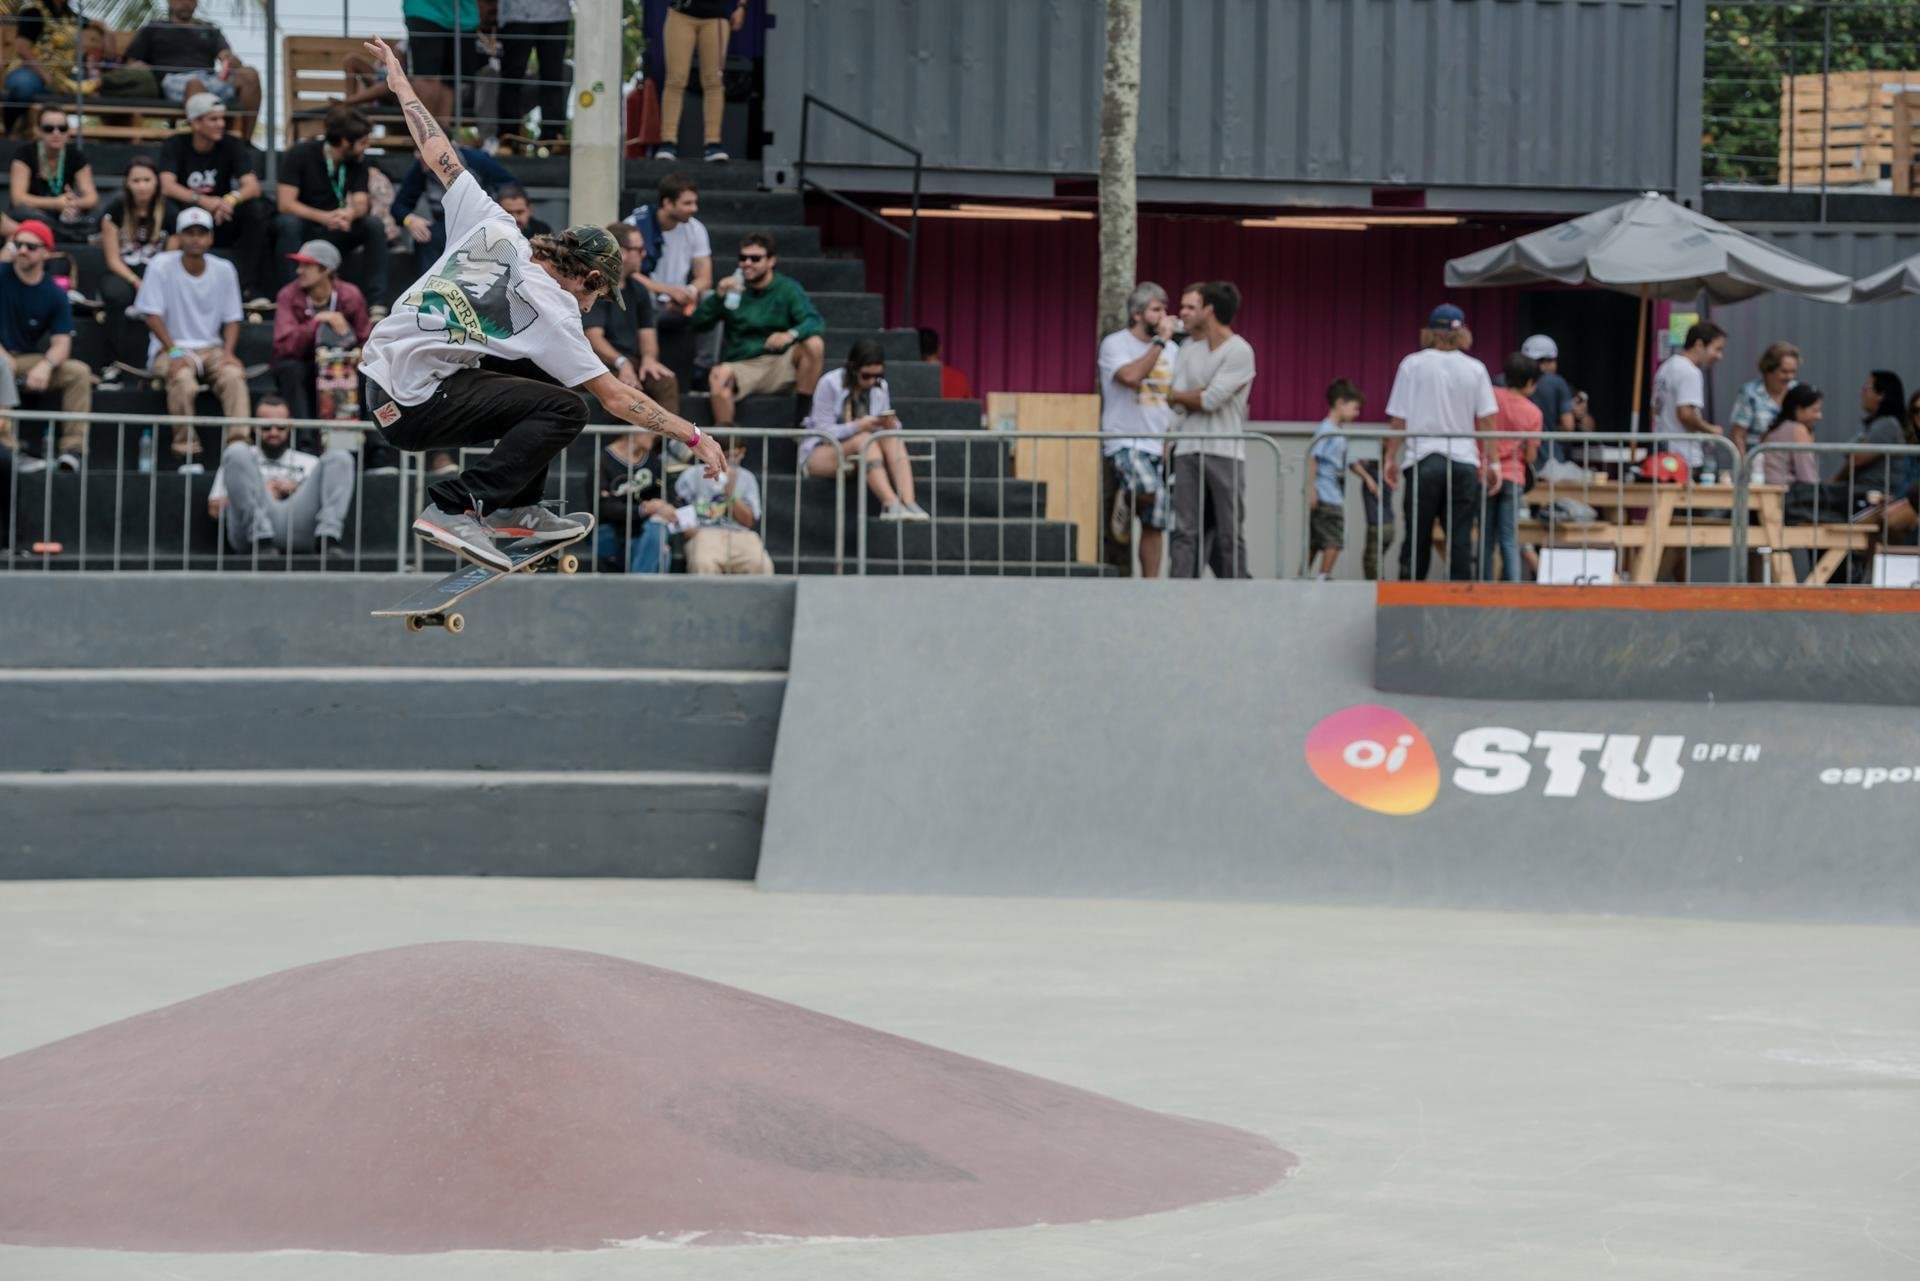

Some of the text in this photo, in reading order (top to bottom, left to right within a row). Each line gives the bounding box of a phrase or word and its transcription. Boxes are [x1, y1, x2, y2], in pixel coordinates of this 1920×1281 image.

[447, 289, 479, 333] STRE
[519, 513, 540, 529] N
[1344, 735, 1414, 774] oi
[1452, 727, 1761, 801] STU OPEN
